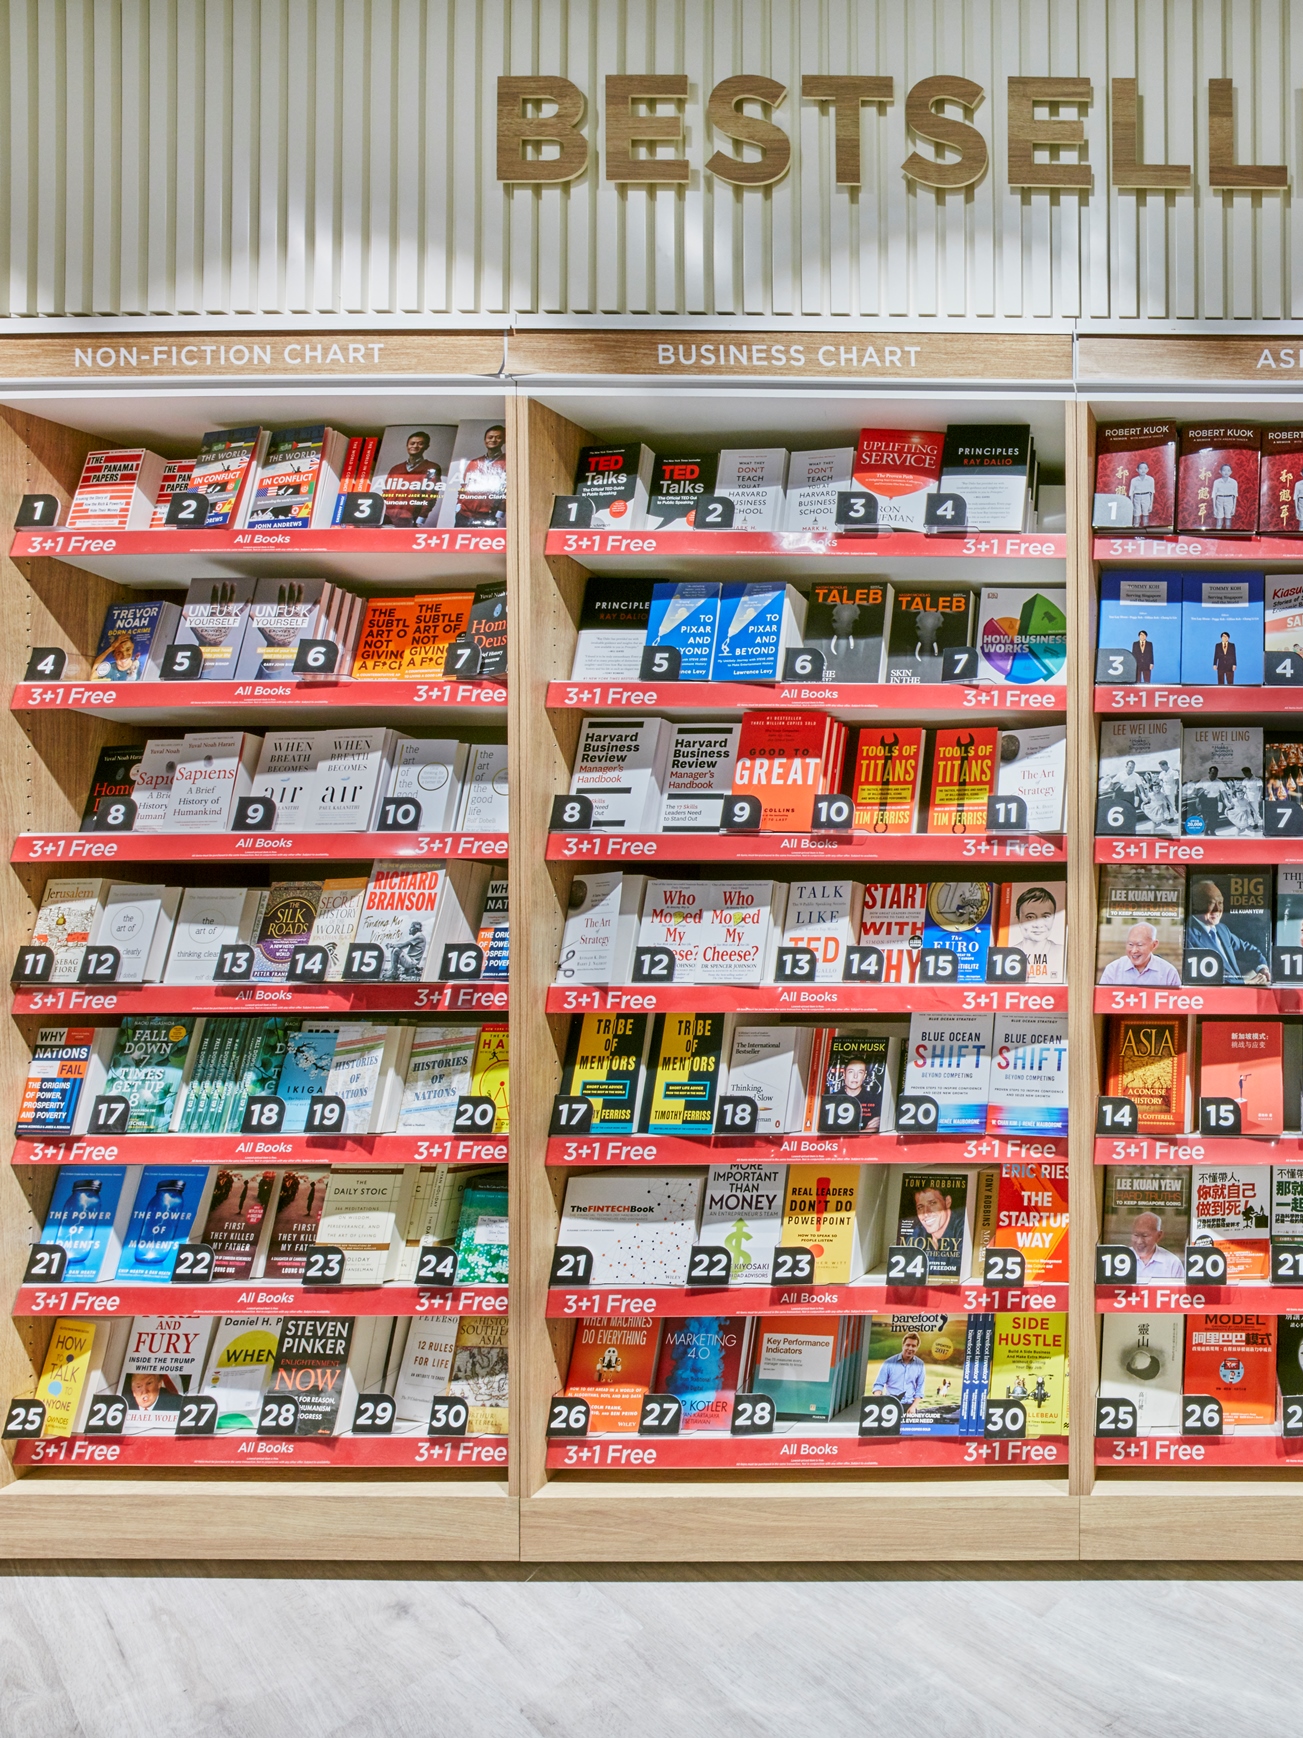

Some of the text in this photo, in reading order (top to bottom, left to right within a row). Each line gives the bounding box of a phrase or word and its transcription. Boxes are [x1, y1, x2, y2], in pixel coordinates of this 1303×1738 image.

[74, 344, 384, 367] NON-FICTION CHART
[658, 344, 921, 367] BUSINESS CHART
[1189, 429, 1253, 439] ROBERT KUOK
[862, 441, 938, 455] UPLIFTING
[958, 447, 1020, 456] PRINCIPLES
[103, 463, 134, 473] PANAMA
[588, 455, 623, 471] TED
[861, 451, 936, 470] SERVICE
[963, 457, 1012, 466] RAY DALIO
[92, 473, 119, 482] PAPERS
[262, 473, 313, 485] IN CONFLICT
[586, 470, 627, 486] Talks
[33, 502, 42, 519] 1
[936, 500, 955, 519] 4
[28, 536, 116, 553] 3+1 Free
[234, 534, 290, 544] All Books
[412, 532, 505, 550] 3+1 Free
[815, 588, 883, 605] TALEB
[112, 607, 158, 620] TREVOR
[116, 617, 149, 628] NOAH
[748, 625, 777, 634] PIXAR
[983, 635, 1067, 645] HOW BUSINESS
[735, 646, 775, 656] BEYOND
[983, 643, 1029, 654] WORKS
[564, 688, 657, 704] 3+1 Free
[781, 689, 838, 700] All Books
[1113, 724, 1167, 735] LEE WEI LING
[333, 741, 371, 751] WHEN
[675, 739, 727, 748] Harvard
[862, 745, 917, 757] TOOLS OF
[673, 749, 729, 759] Business
[671, 759, 718, 768] Review
[861, 760, 915, 782] TITANS
[175, 766, 235, 782] Sapiens
[670, 770, 715, 780] Manager's
[735, 758, 821, 785] GREAT
[668, 780, 713, 789] Handbook
[321, 785, 361, 803] air
[385, 805, 416, 824] 10
[1113, 842, 1203, 858] 3+1 Free
[373, 872, 439, 889] RICHARD
[1230, 879, 1263, 894] BIG
[46, 888, 94, 900] Jerusalem
[367, 891, 436, 910] BRANSON
[1230, 894, 1263, 905] IDEAS
[703, 944, 758, 962] Cheese?
[295, 954, 323, 973] 14
[35, 1048, 88, 1059] NATIONS
[833, 1042, 885, 1051] ELON MUSK
[413, 1055, 468, 1073] HISTORIES
[662, 1056, 715, 1072] MENTORS
[914, 1044, 986, 1069] SHIFT
[60, 1064, 84, 1076] FAIL
[98, 1104, 123, 1123] 17
[334, 1186, 387, 1196] DAILY STOIC
[1197, 1183, 1256, 1199] 你就自己
[570, 1205, 655, 1214] TheFINTECHBook
[709, 1194, 777, 1211] MONEY
[788, 1216, 852, 1226] POWERPOINT
[307, 1253, 339, 1276] 23
[892, 1256, 924, 1277] 24
[286, 1320, 348, 1338] STEVEN
[136, 1333, 197, 1354] FURY
[666, 1333, 737, 1348] MARKETING
[767, 1336, 830, 1348] Key Performance
[999, 1333, 1061, 1347] HUSTLE
[1192, 1332, 1272, 1345] 阿里巴巴模式
[282, 1338, 346, 1355] PINKER
[274, 1367, 340, 1392] NOW
[737, 1403, 770, 1425] 28
